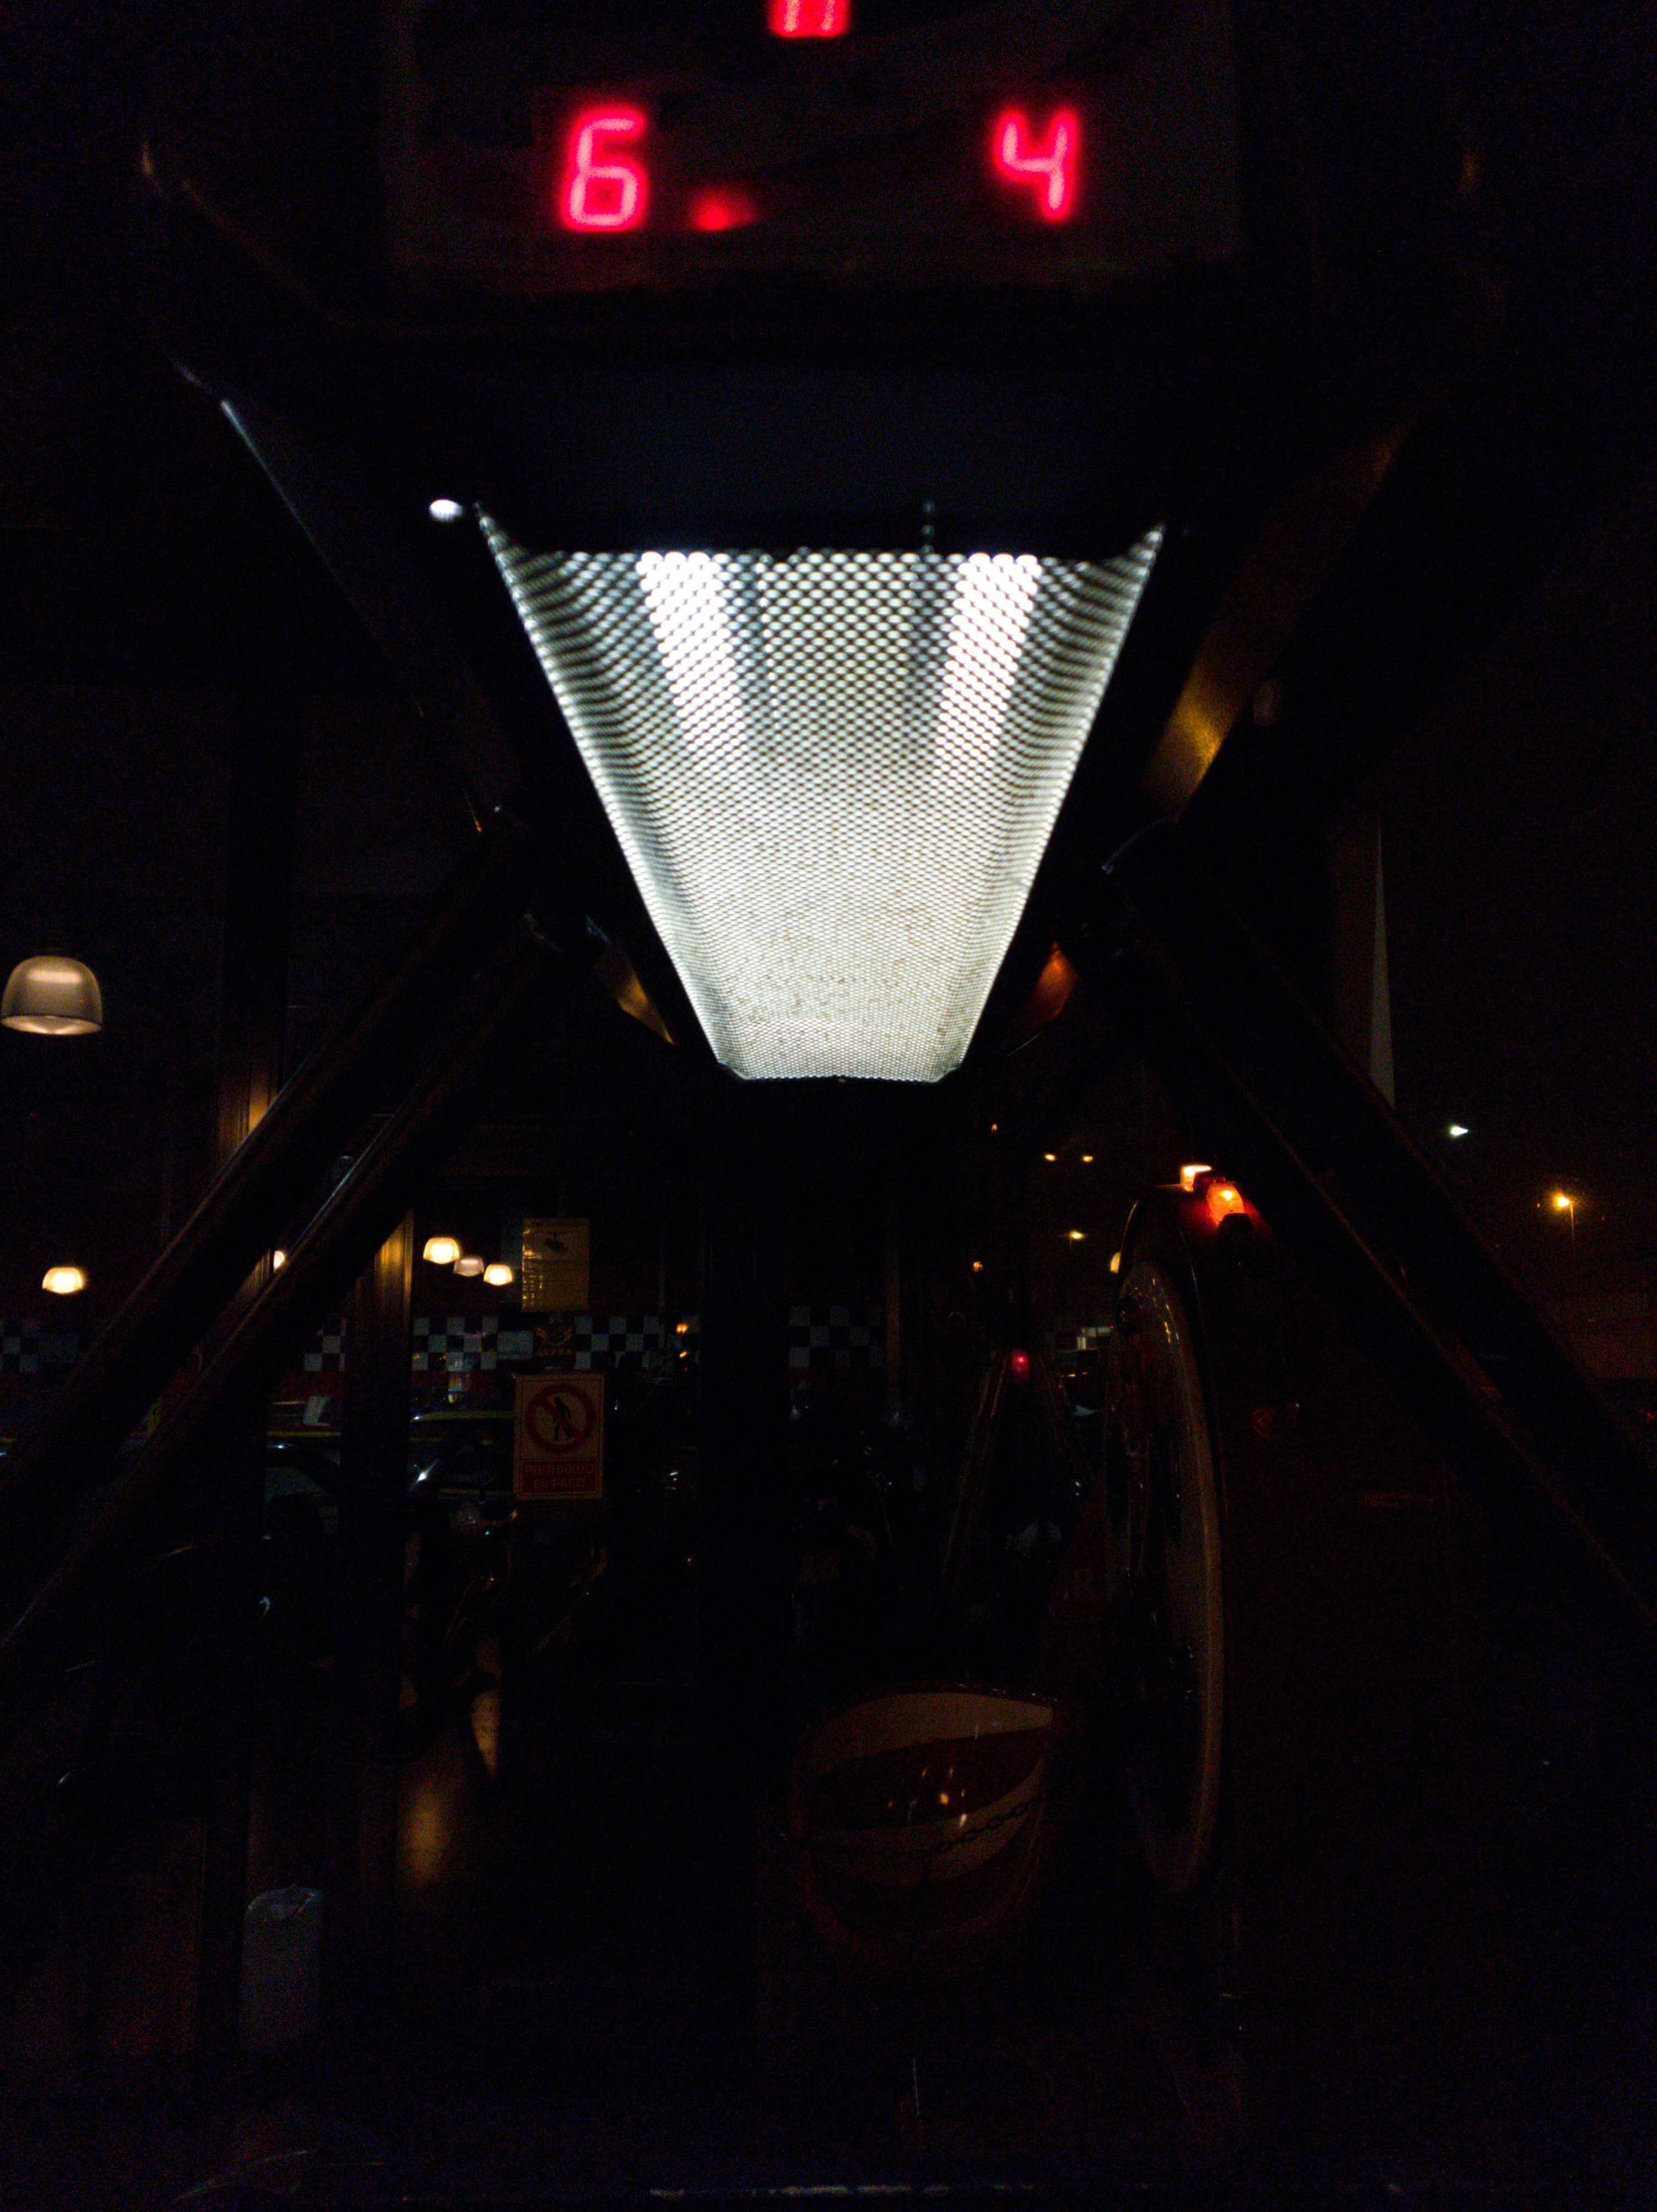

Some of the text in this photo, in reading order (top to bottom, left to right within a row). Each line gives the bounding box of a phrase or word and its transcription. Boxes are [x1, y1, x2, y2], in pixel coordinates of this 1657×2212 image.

[563, 111, 646, 230] 6
[996, 114, 1074, 216] 4
[525, 1464, 595, 1474] PROHIBIDO
